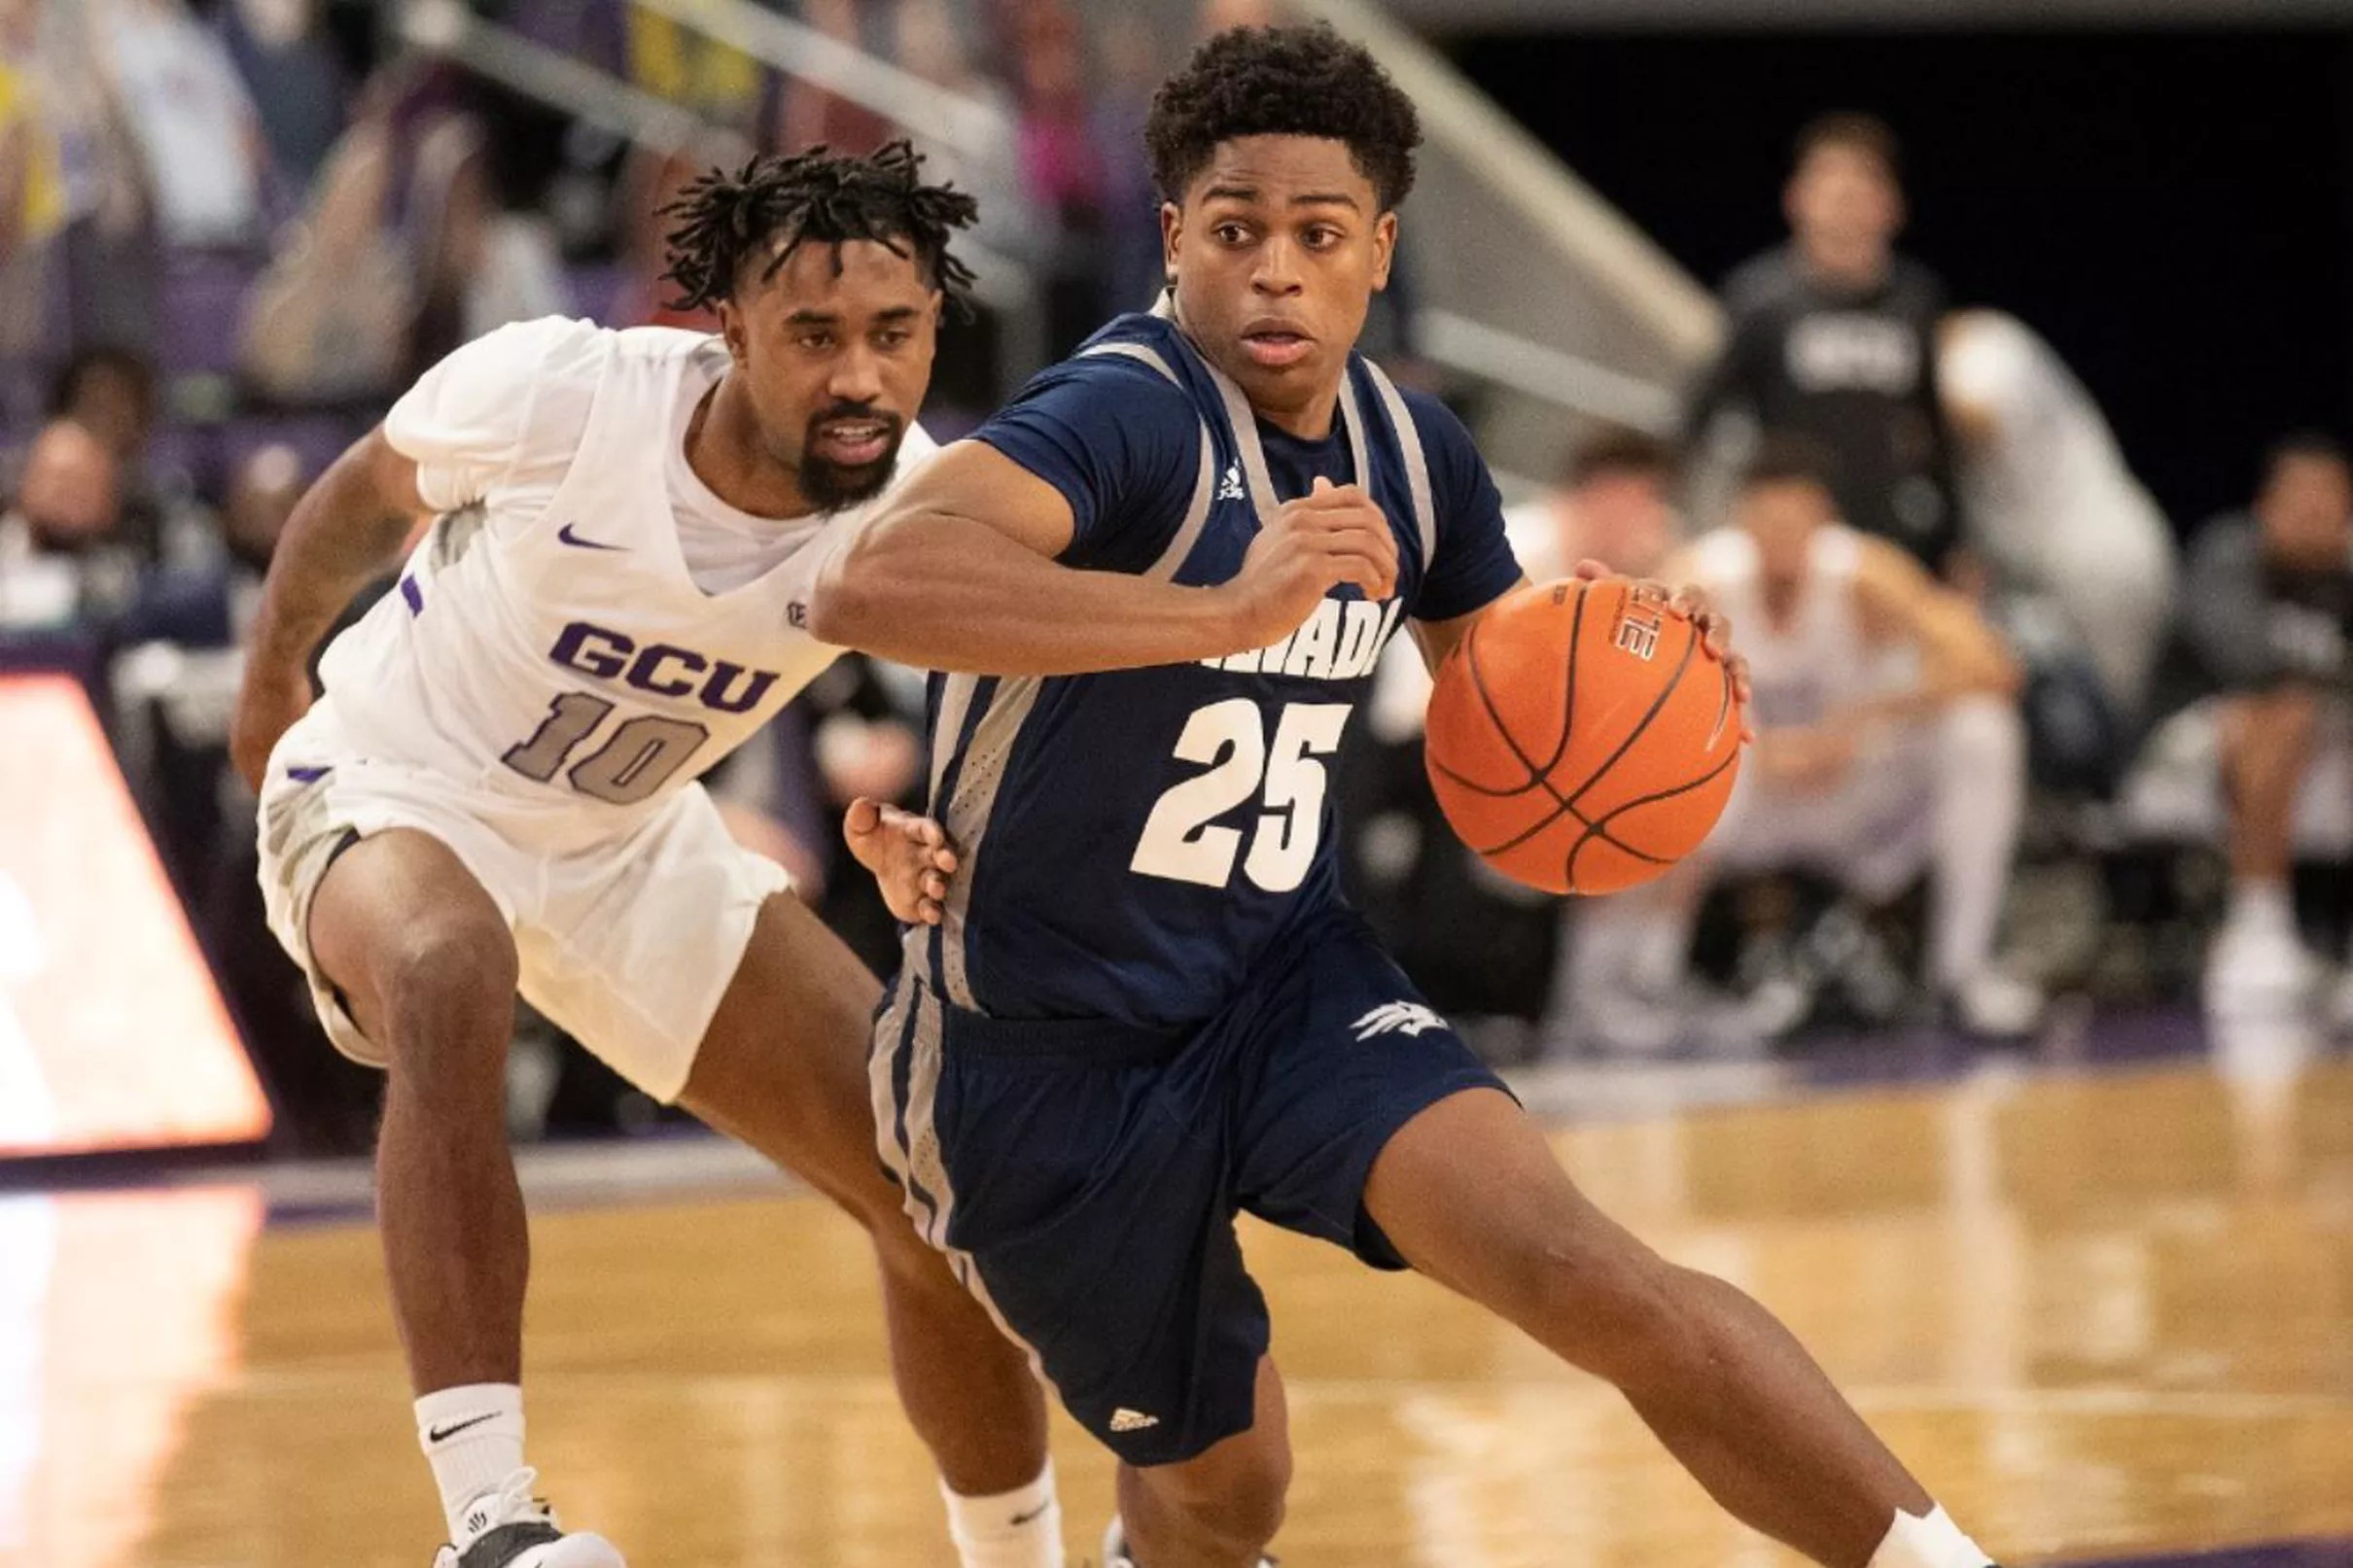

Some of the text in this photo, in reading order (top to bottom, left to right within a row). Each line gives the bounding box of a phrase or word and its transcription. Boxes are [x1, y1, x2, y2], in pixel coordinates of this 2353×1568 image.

[549, 621, 781, 714] GCU
[501, 691, 710, 806] 10
[1129, 697, 1353, 892] 25
